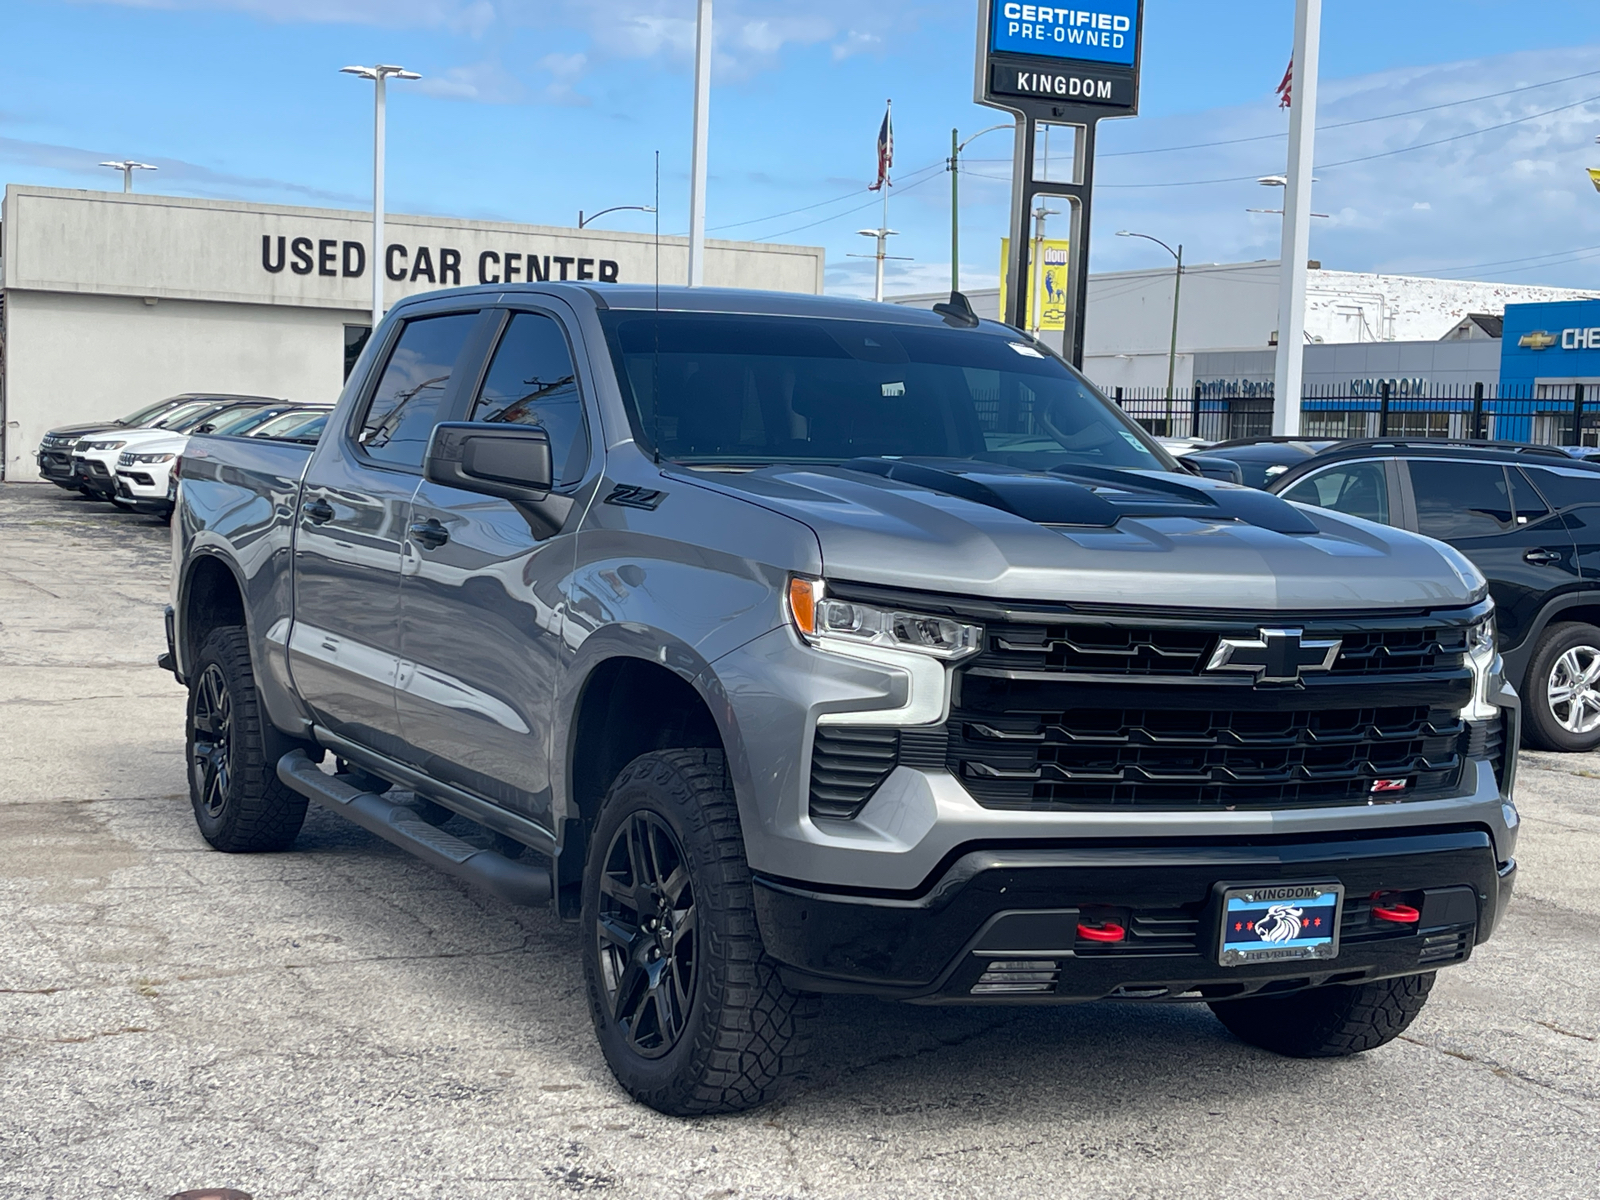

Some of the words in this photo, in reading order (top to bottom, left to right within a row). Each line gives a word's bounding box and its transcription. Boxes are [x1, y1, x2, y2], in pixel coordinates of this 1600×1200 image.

[1004, 2, 1130, 31] CERTIFIED
[1008, 21, 1124, 48] PRE-OWNED
[1017, 71, 1112, 98] KINGDOM
[262, 235, 366, 278] USED
[385, 243, 461, 285] CAR
[478, 250, 619, 284] CENTER
[1561, 327, 1600, 350] CHE
[1195, 378, 1238, 395] Certified
[1242, 378, 1275, 397] Servic
[1350, 378, 1424, 396] KINGDOM
[1254, 887, 1315, 900] KINGDOM
